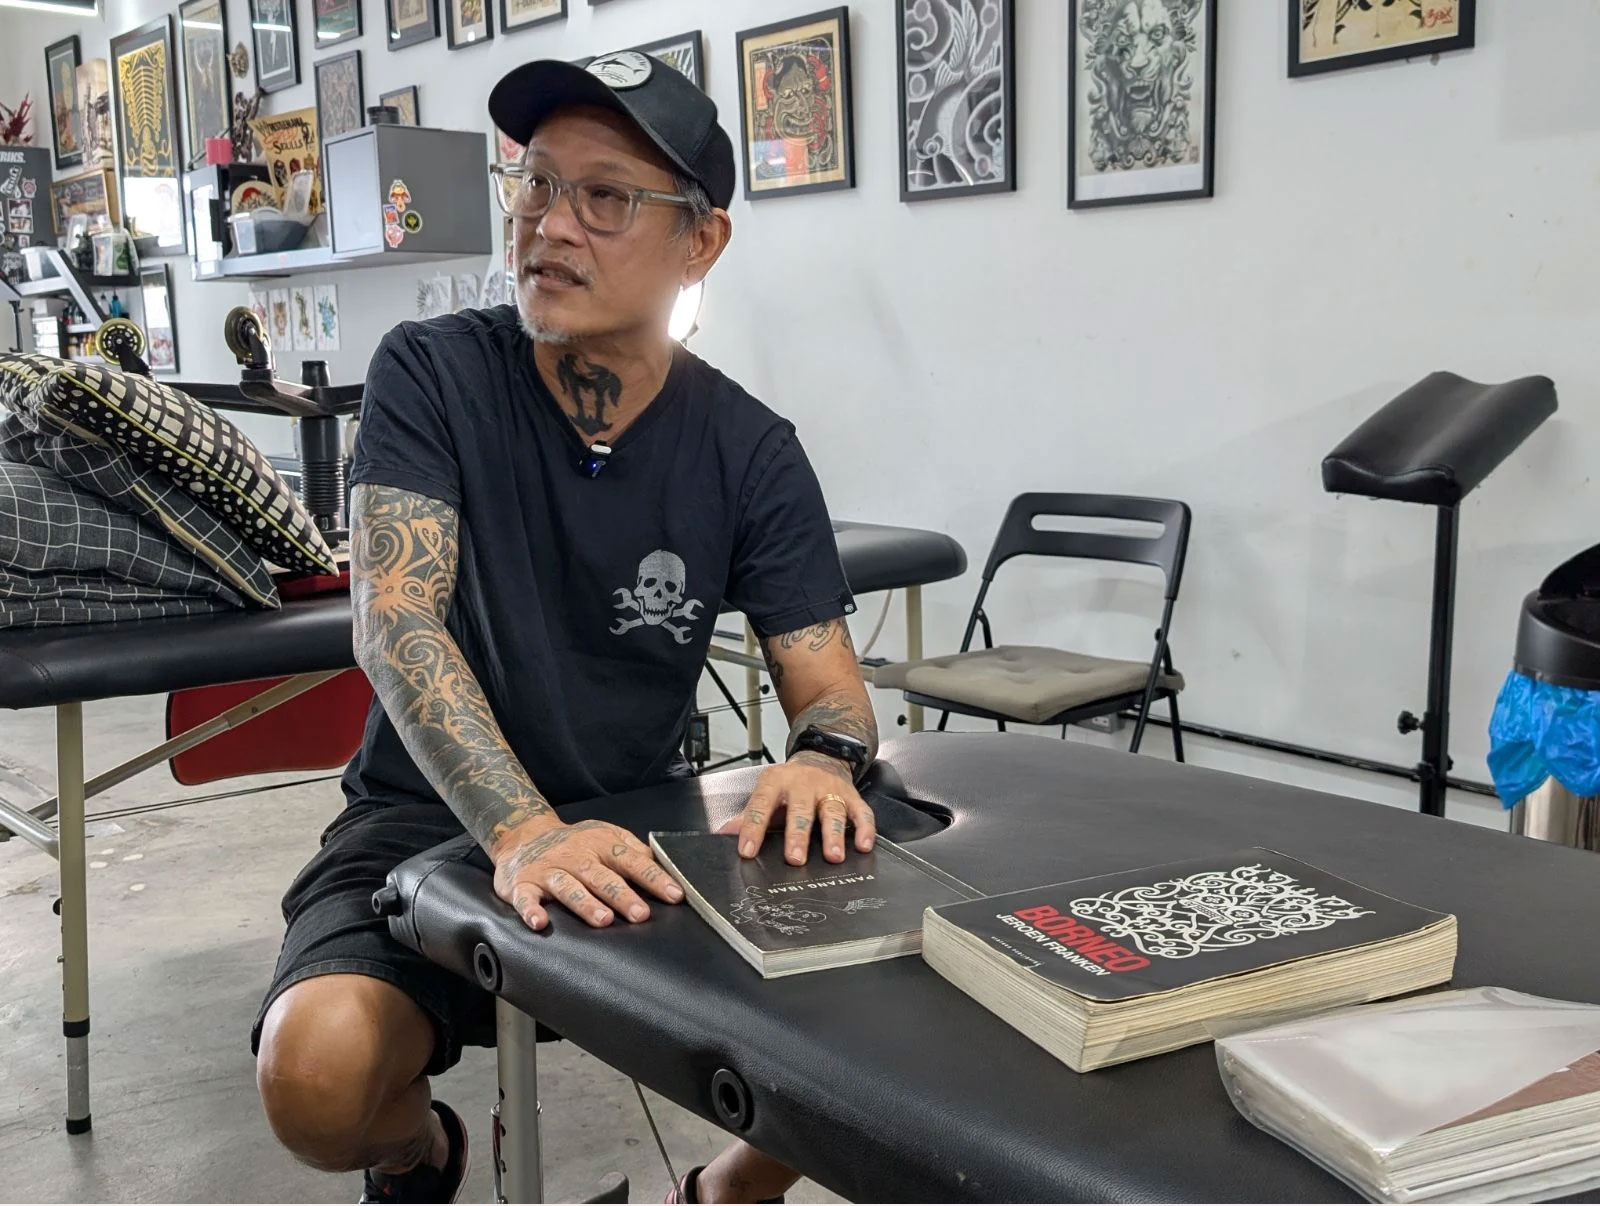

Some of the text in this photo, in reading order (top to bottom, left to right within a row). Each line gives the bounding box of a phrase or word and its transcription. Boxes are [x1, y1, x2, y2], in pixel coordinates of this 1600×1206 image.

[767, 885, 804, 894] IBAN
[806, 874, 875, 889] PANTANG
[996, 913, 1051, 943] JEROEN
[1042, 941, 1112, 976] FRANKEN
[1013, 904, 1151, 972] BORNEO
